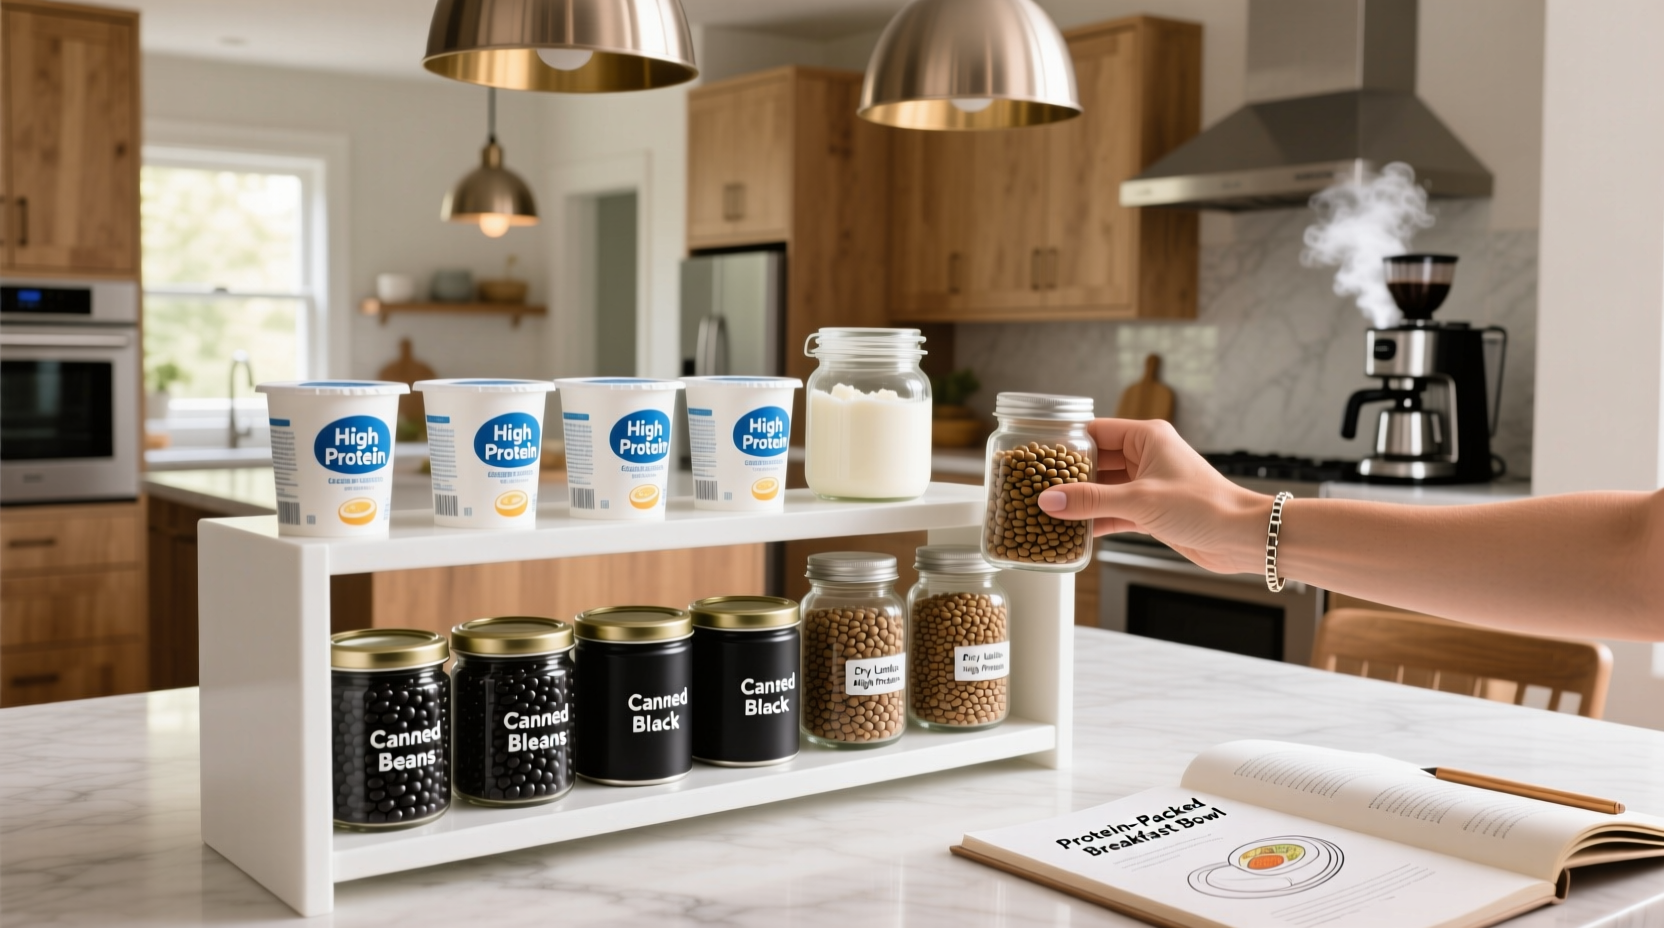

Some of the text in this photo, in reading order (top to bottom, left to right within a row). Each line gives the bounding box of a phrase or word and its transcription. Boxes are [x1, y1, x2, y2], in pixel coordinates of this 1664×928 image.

[494, 423, 532, 445] High
[627, 419, 663, 441] High
[749, 416, 783, 437] High
[335, 426, 379, 450] High
[325, 446, 386, 466] Protein
[485, 441, 537, 461] Protein
[628, 686, 688, 711] Canned
[745, 695, 790, 716] Black
[503, 703, 569, 730] Canned
[632, 711, 680, 733] Black
[369, 719, 441, 749] Canned
[508, 731, 567, 752] Bleans
[378, 749, 436, 773] Beans
[1056, 797, 1206, 850] Protein-Packed
[1082, 824, 1179, 856] Breakfast
[1175, 807, 1227, 829] Bowl
